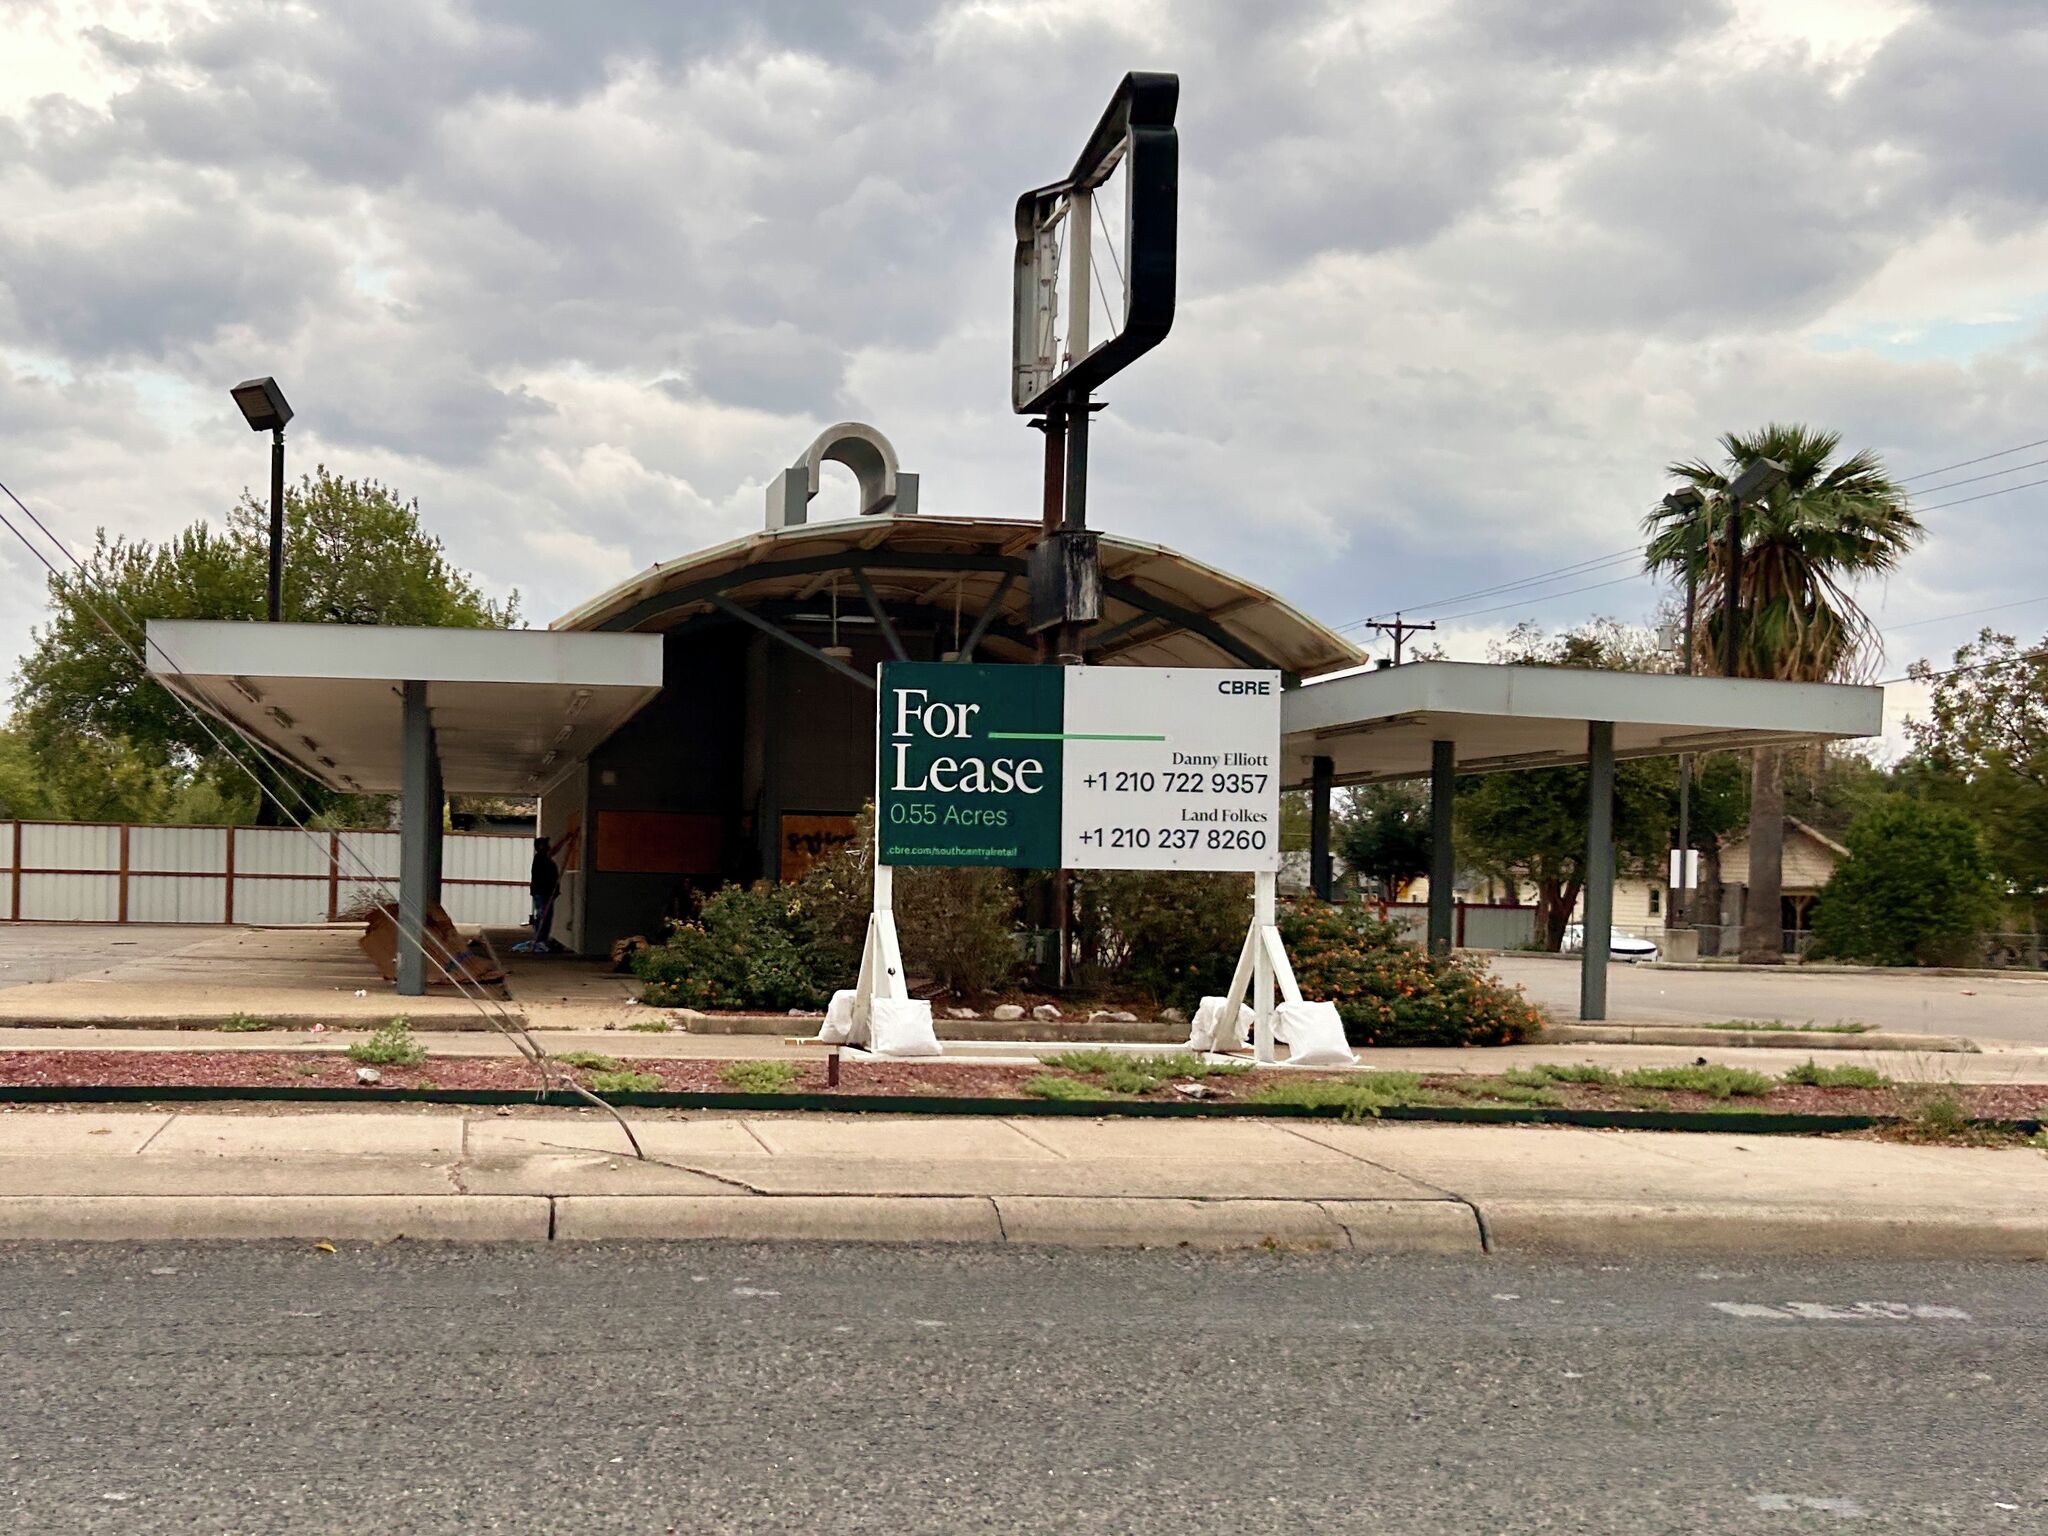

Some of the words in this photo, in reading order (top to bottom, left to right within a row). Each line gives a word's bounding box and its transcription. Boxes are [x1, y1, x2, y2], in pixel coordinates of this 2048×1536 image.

[1218, 680, 1270, 695] CBRE
[891, 688, 981, 738] For
[891, 743, 1044, 794] Lease
[1172, 752, 1220, 769] Danny
[1224, 753, 1269, 766] Elliott
[1083, 771, 1108, 792] +1
[1115, 771, 1155, 793] 210
[1162, 772, 1204, 793] 722
[1211, 773, 1268, 794] 9357
[890, 803, 937, 825] 0.55
[943, 804, 1008, 826] Acres
[1181, 808, 1218, 822] Land
[1222, 809, 1268, 823] Folkes
[1079, 827, 1103, 848] +1
[1111, 828, 1150, 849] 210
[1158, 829, 1200, 849] 237
[1207, 829, 1266, 850] 8260
